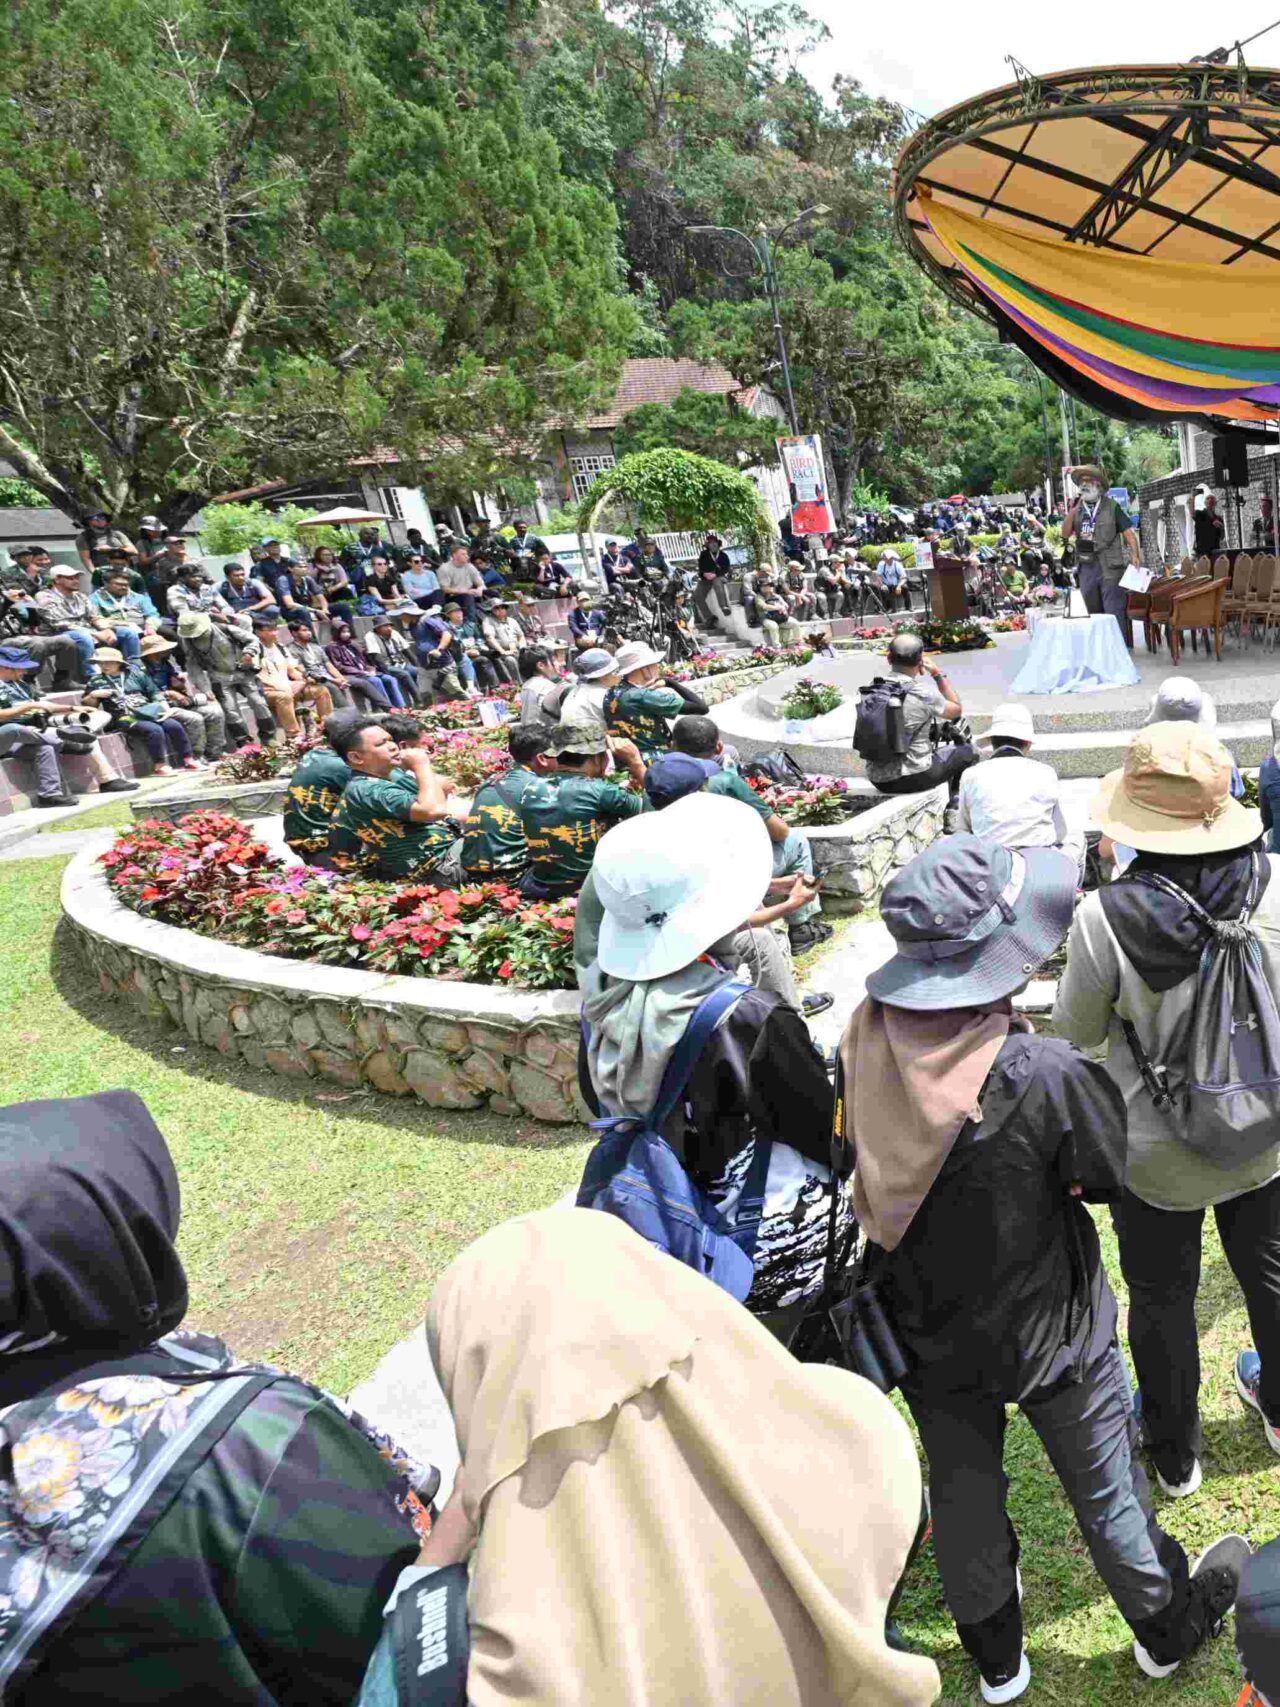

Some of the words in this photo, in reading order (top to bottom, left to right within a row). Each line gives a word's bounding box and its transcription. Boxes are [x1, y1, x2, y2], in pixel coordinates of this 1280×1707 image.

[790, 456, 815, 470] BIRD
[792, 469, 815, 479] RACE
[416, 1585, 448, 1677] Bushnell
